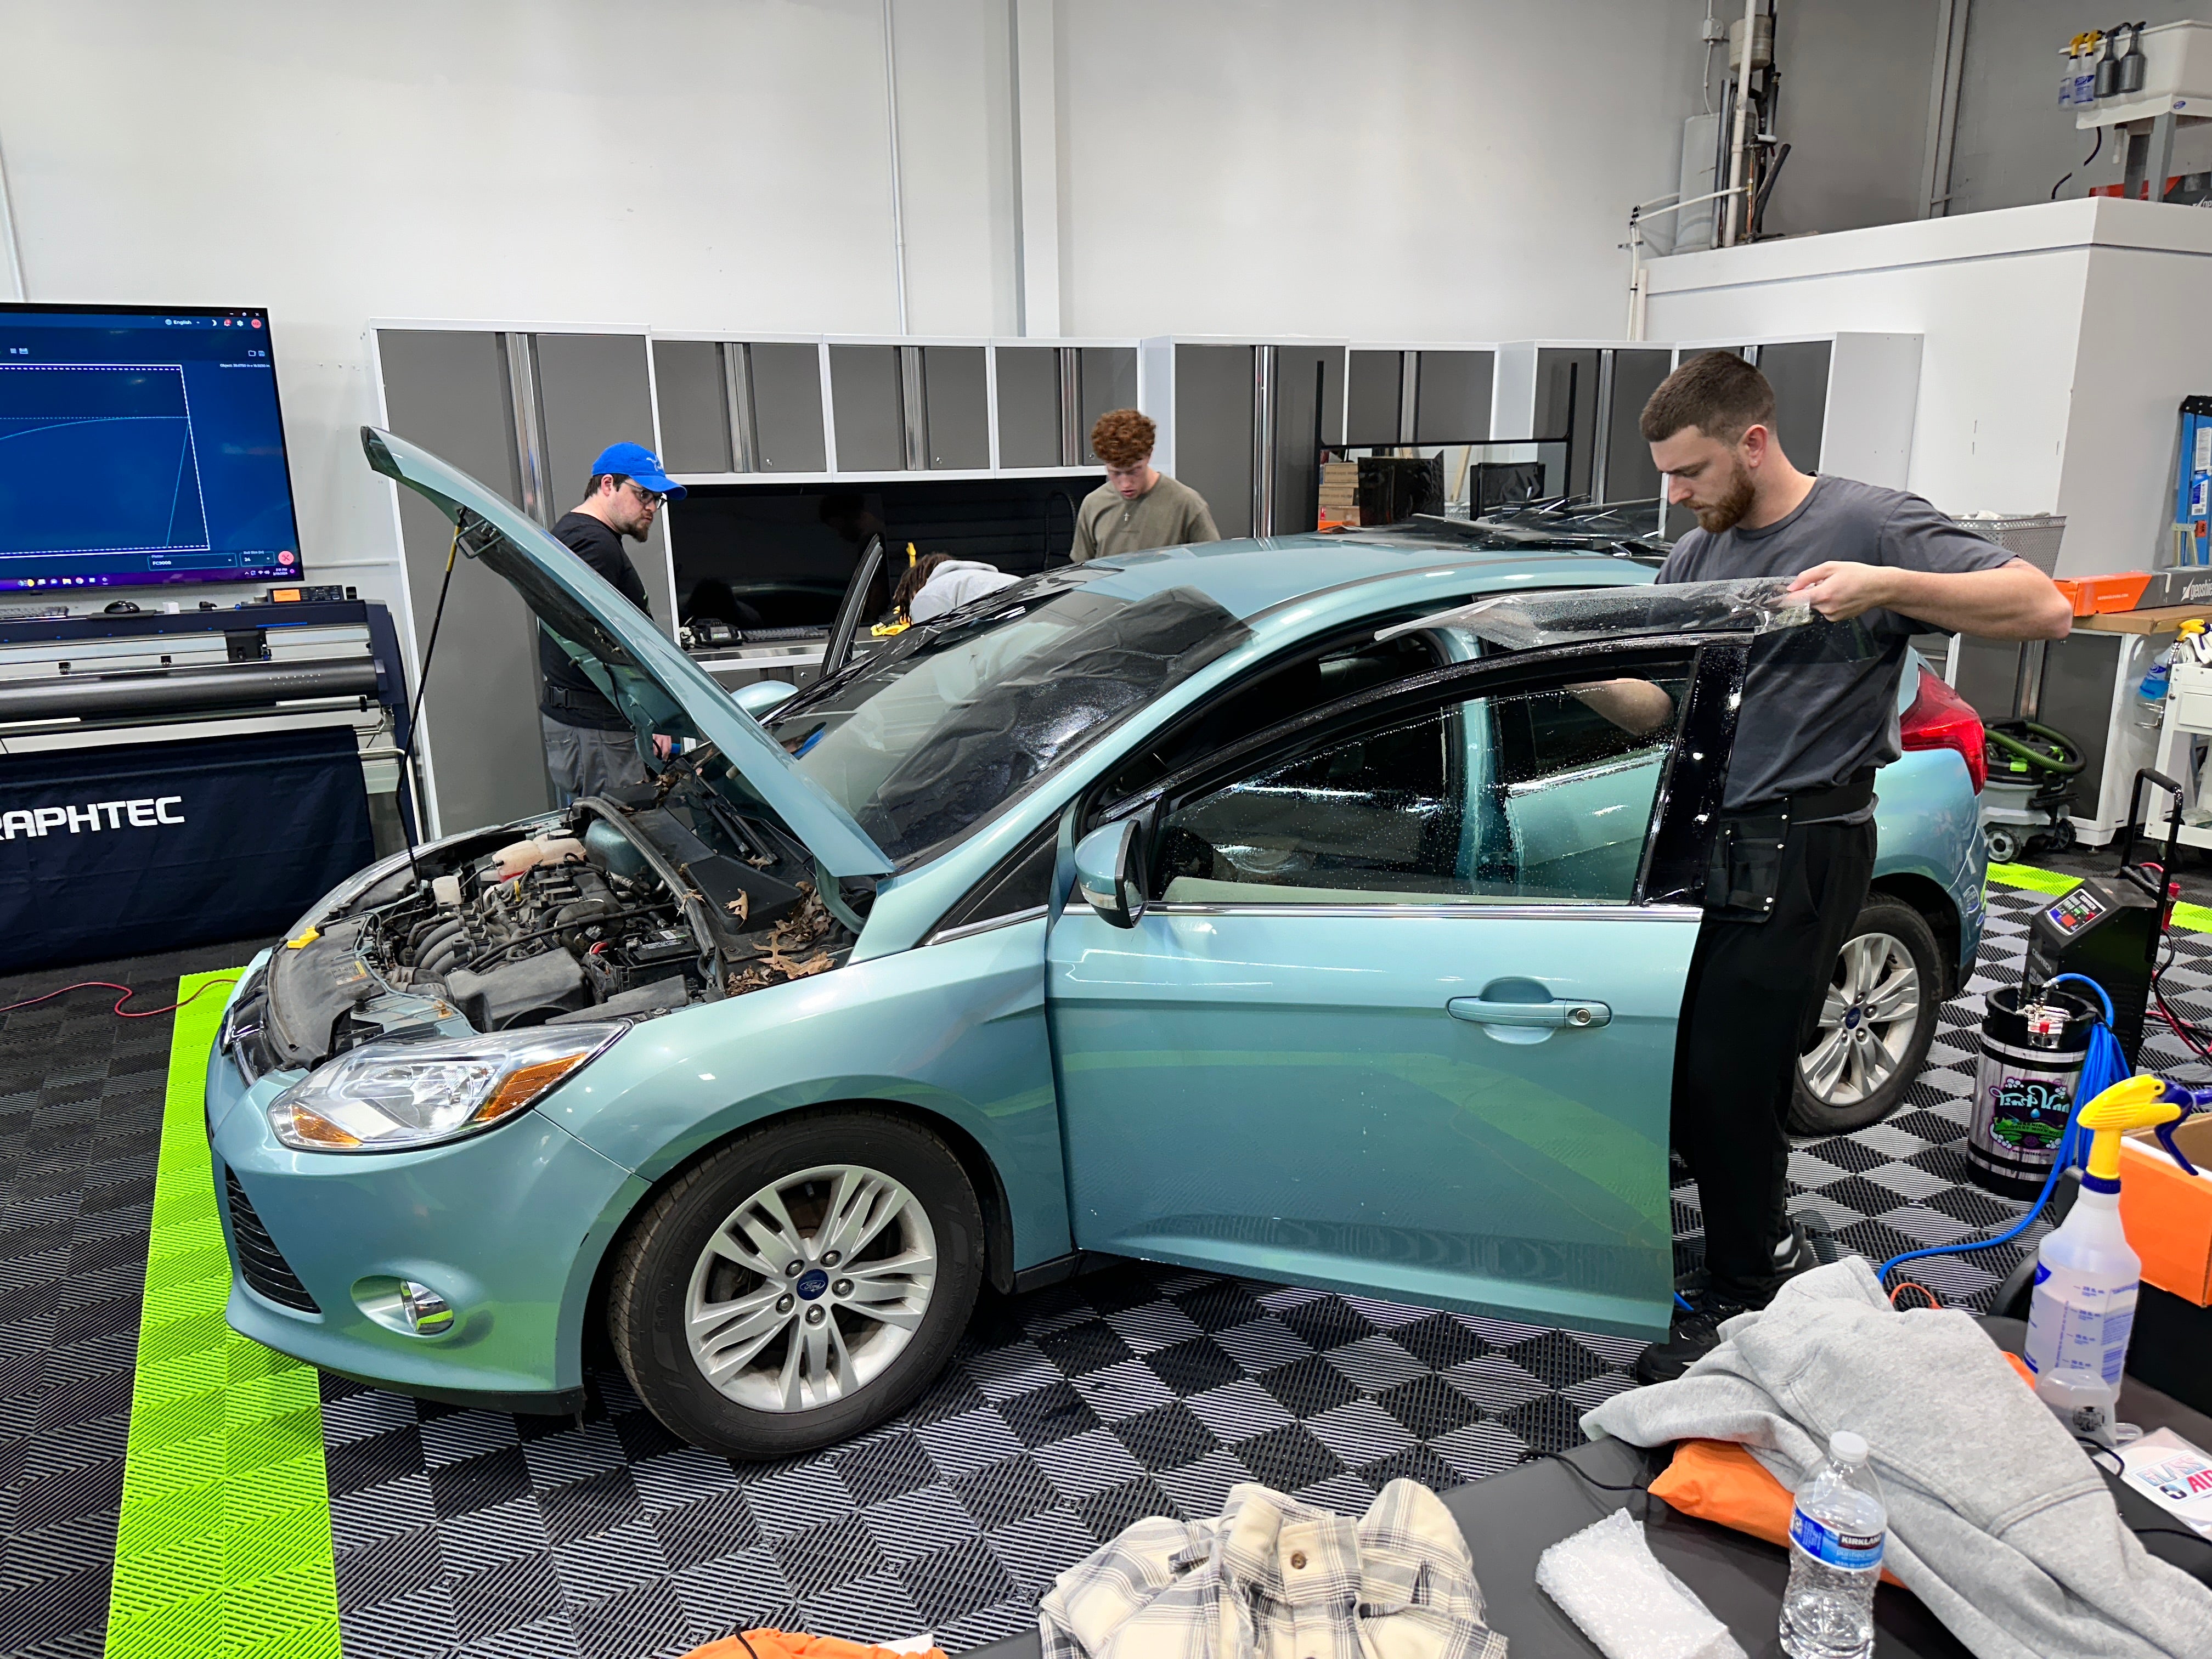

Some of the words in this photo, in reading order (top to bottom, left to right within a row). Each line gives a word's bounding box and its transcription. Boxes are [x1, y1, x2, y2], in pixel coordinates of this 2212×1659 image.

[0, 795, 185, 840] APHTEC
[804, 1282, 821, 1290] Ford
[2136, 1454, 2208, 1487] GLASS
